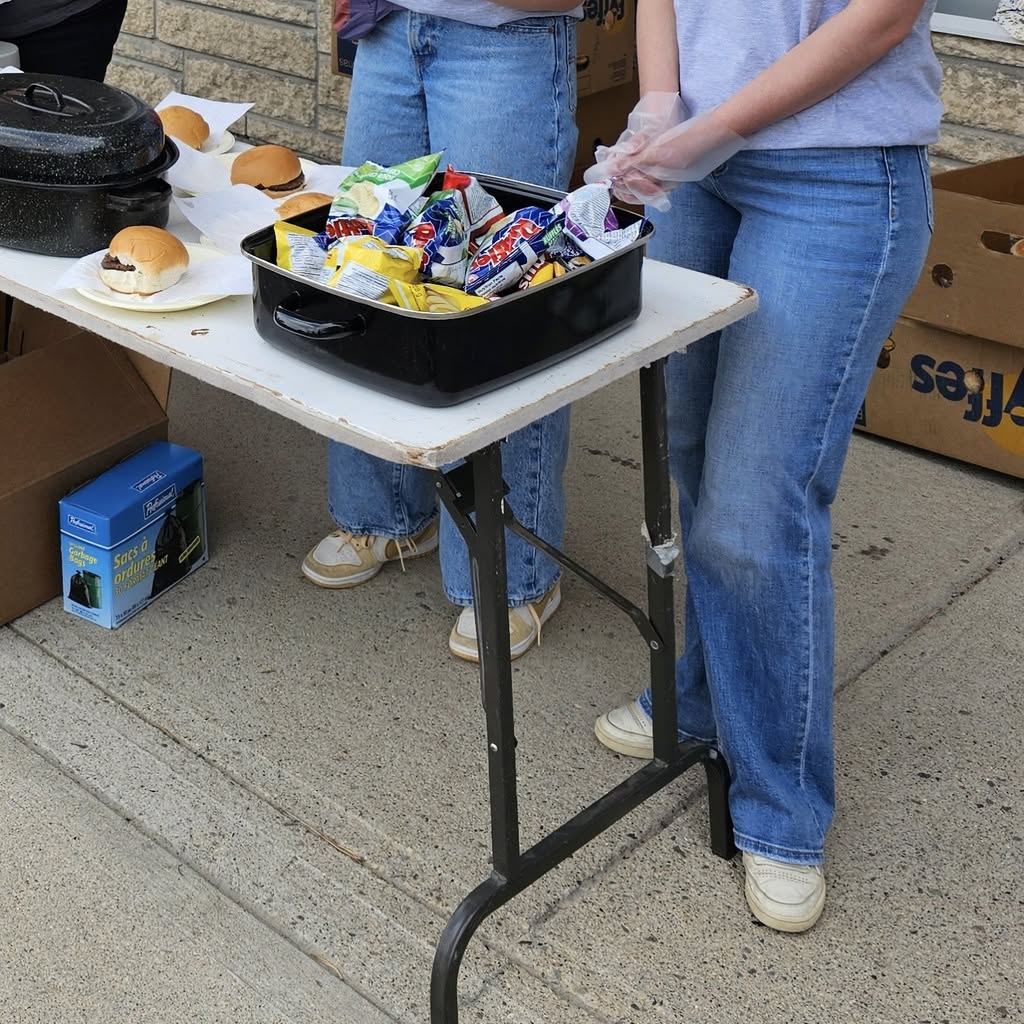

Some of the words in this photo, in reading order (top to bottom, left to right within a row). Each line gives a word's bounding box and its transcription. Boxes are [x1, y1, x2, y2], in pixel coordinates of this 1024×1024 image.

[68, 547, 97, 565] Garbage
[69, 554, 86, 567] Bags
[114, 546, 138, 569] Sacs
[141, 537, 148, 551] à
[114, 551, 156, 585] ordures
